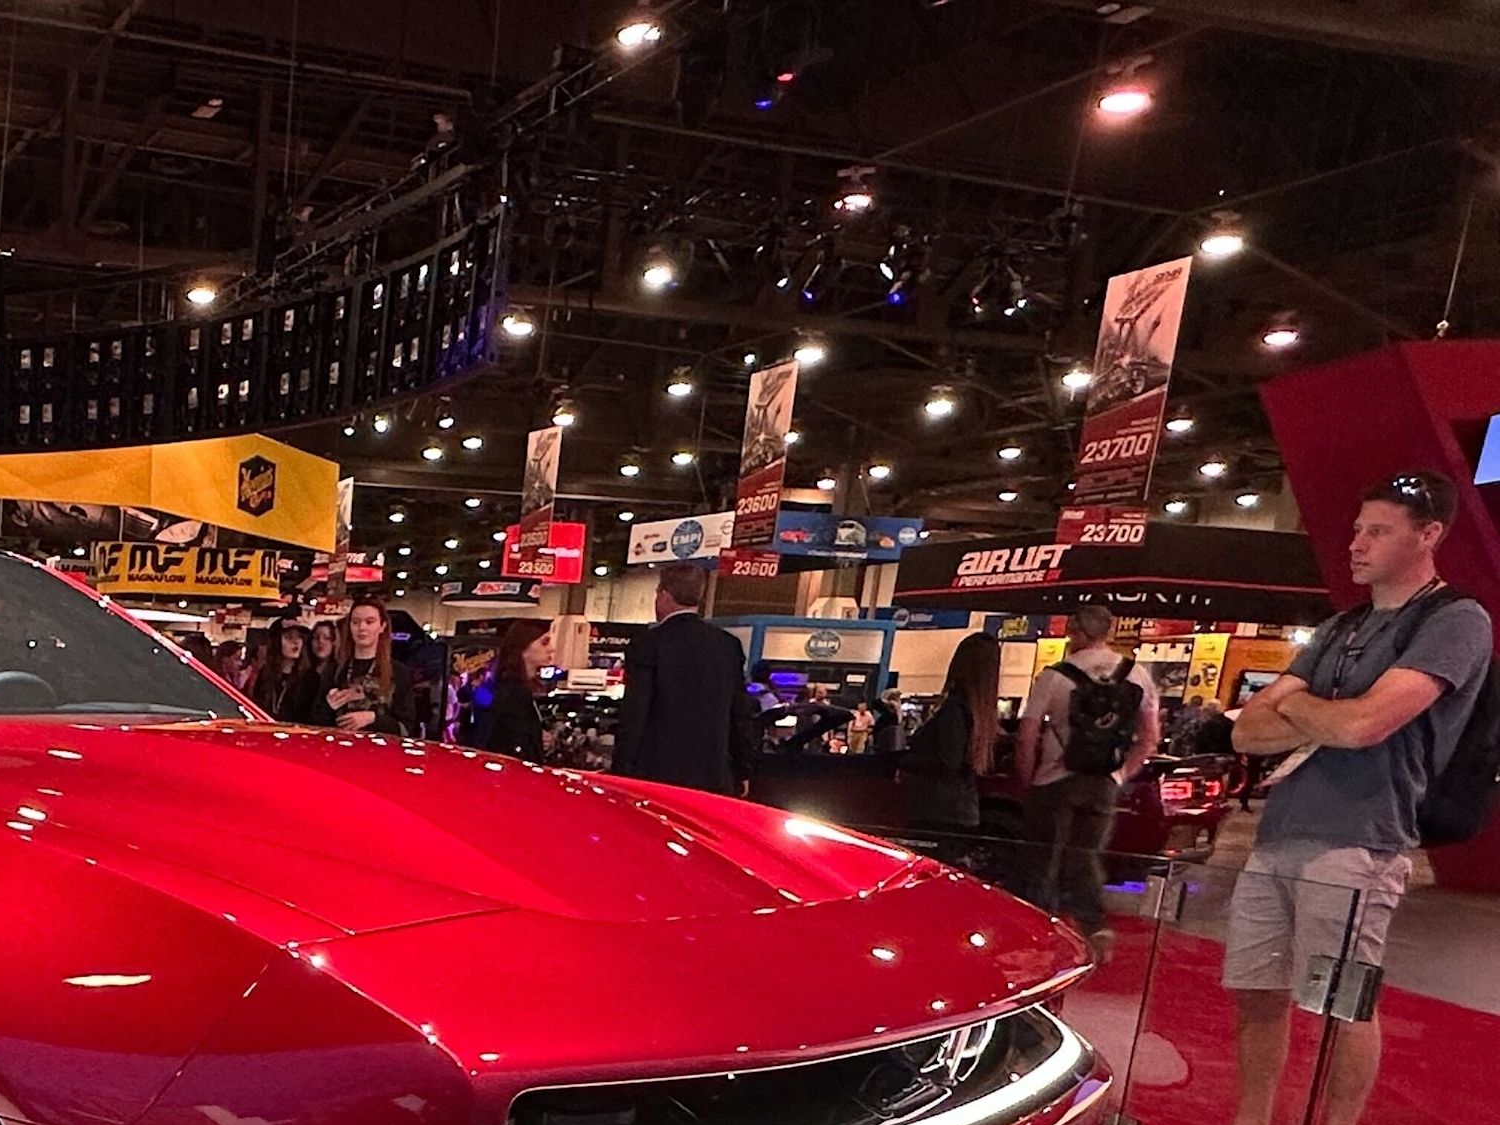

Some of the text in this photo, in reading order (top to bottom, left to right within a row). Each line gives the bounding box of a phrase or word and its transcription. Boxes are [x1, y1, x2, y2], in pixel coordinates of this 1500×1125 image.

[1081, 432, 1152, 464] 23700
[736, 493, 779, 516] 23600
[1080, 524, 1145, 543] 23700
[518, 561, 554, 575] 23500
[1009, 544, 1072, 571] LIFT
[731, 560, 779, 578] 23600
